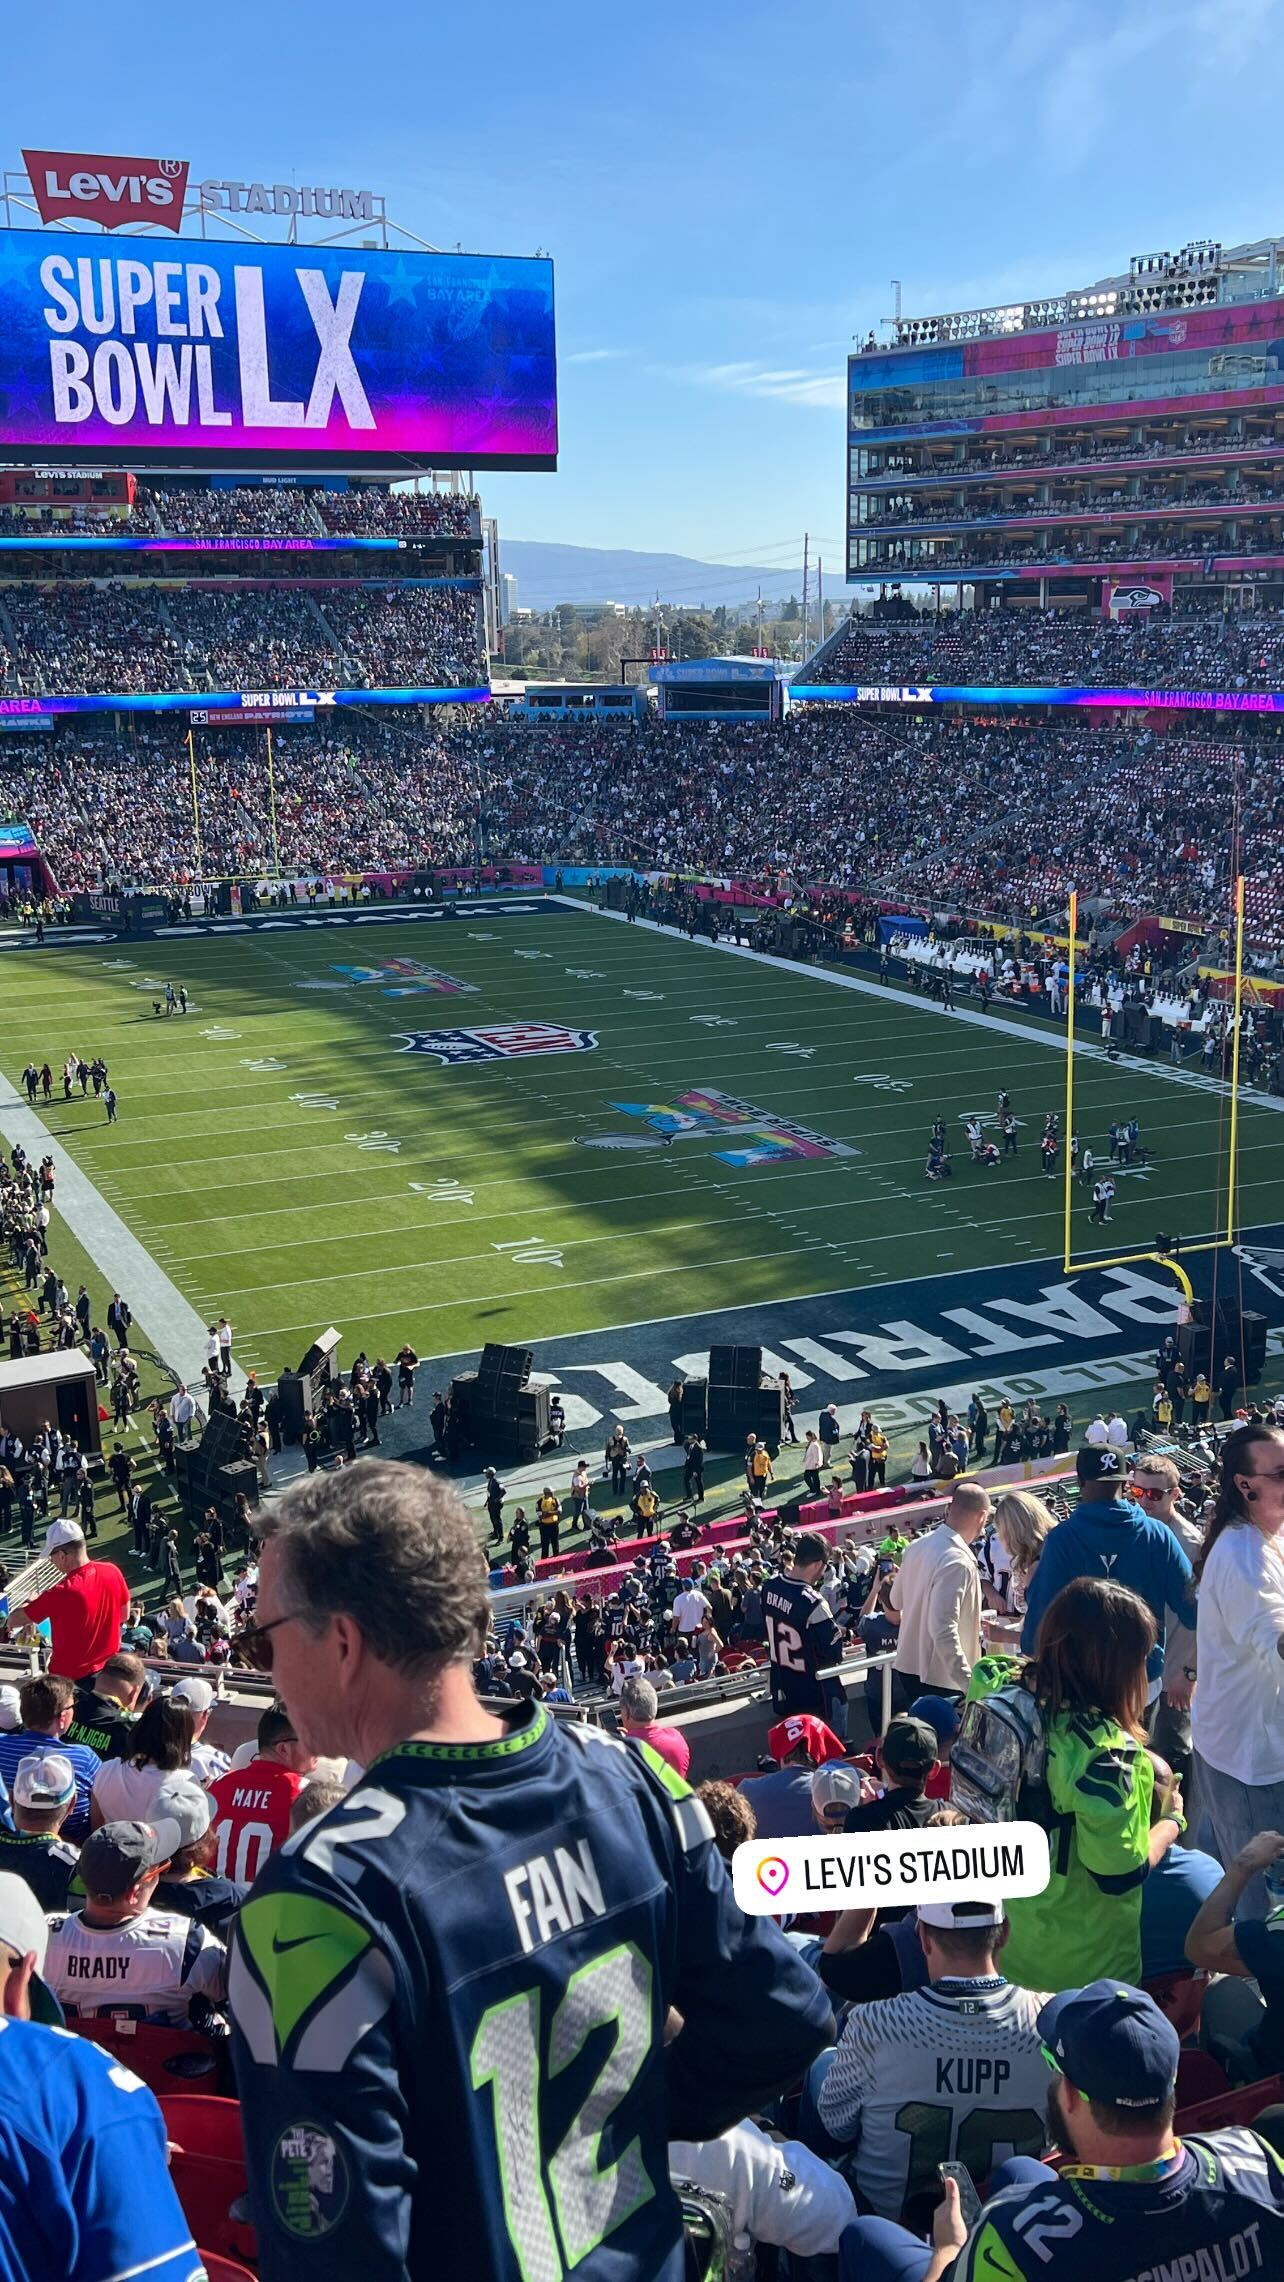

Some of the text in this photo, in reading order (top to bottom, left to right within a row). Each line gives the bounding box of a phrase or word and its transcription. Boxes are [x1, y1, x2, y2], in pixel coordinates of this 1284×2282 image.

[200, 179, 374, 221] STADIUM
[40, 255, 225, 338] SUPER
[233, 265, 378, 430] LX
[49, 340, 233, 427] BOWL
[67, 471, 103, 479] STADIUM
[195, 539, 314, 549] SAN FRANCISCO BAY AREA
[0, 699, 42, 713] AREA
[241, 691, 338, 707] SUPER BOWL LX
[857, 687, 934, 701] SUPER BOWL LX
[1144, 690, 1275, 709] SAN FRANCISCO BAY AREA
[193, 711, 206, 722] 25
[209, 710, 313, 721] NEW ENGLAND PATRIOTS
[89, 894, 120, 913] SEATTLE
[1172, 920, 1187, 931] SUPER
[474, 1025, 579, 1055] NFL
[853, 1073, 914, 1091] 30
[714, 1094, 838, 1148] SUPER BOWL
[344, 1130, 402, 1150] 30
[407, 1177, 476, 1201] 20
[490, 1236, 565, 1265] 10
[974, 1377, 1048, 1404] OF
[863, 1395, 953, 1423] US
[1100, 1452, 1119, 1471] R
[766, 1591, 794, 1616] BRADY
[765, 1615, 807, 1673] 12
[67, 1721, 112, 1752] H-NJIGBA
[231, 1787, 272, 1810] MAYE
[215, 1818, 274, 1884] 10
[504, 1839, 607, 1954] FAN
[67, 1955, 131, 1980] BRADY
[963, 2002, 975, 2014] 12
[936, 2057, 1011, 2095] KUPP
[470, 1940, 657, 2282] 12
[1012, 2195, 1084, 2264] 12
